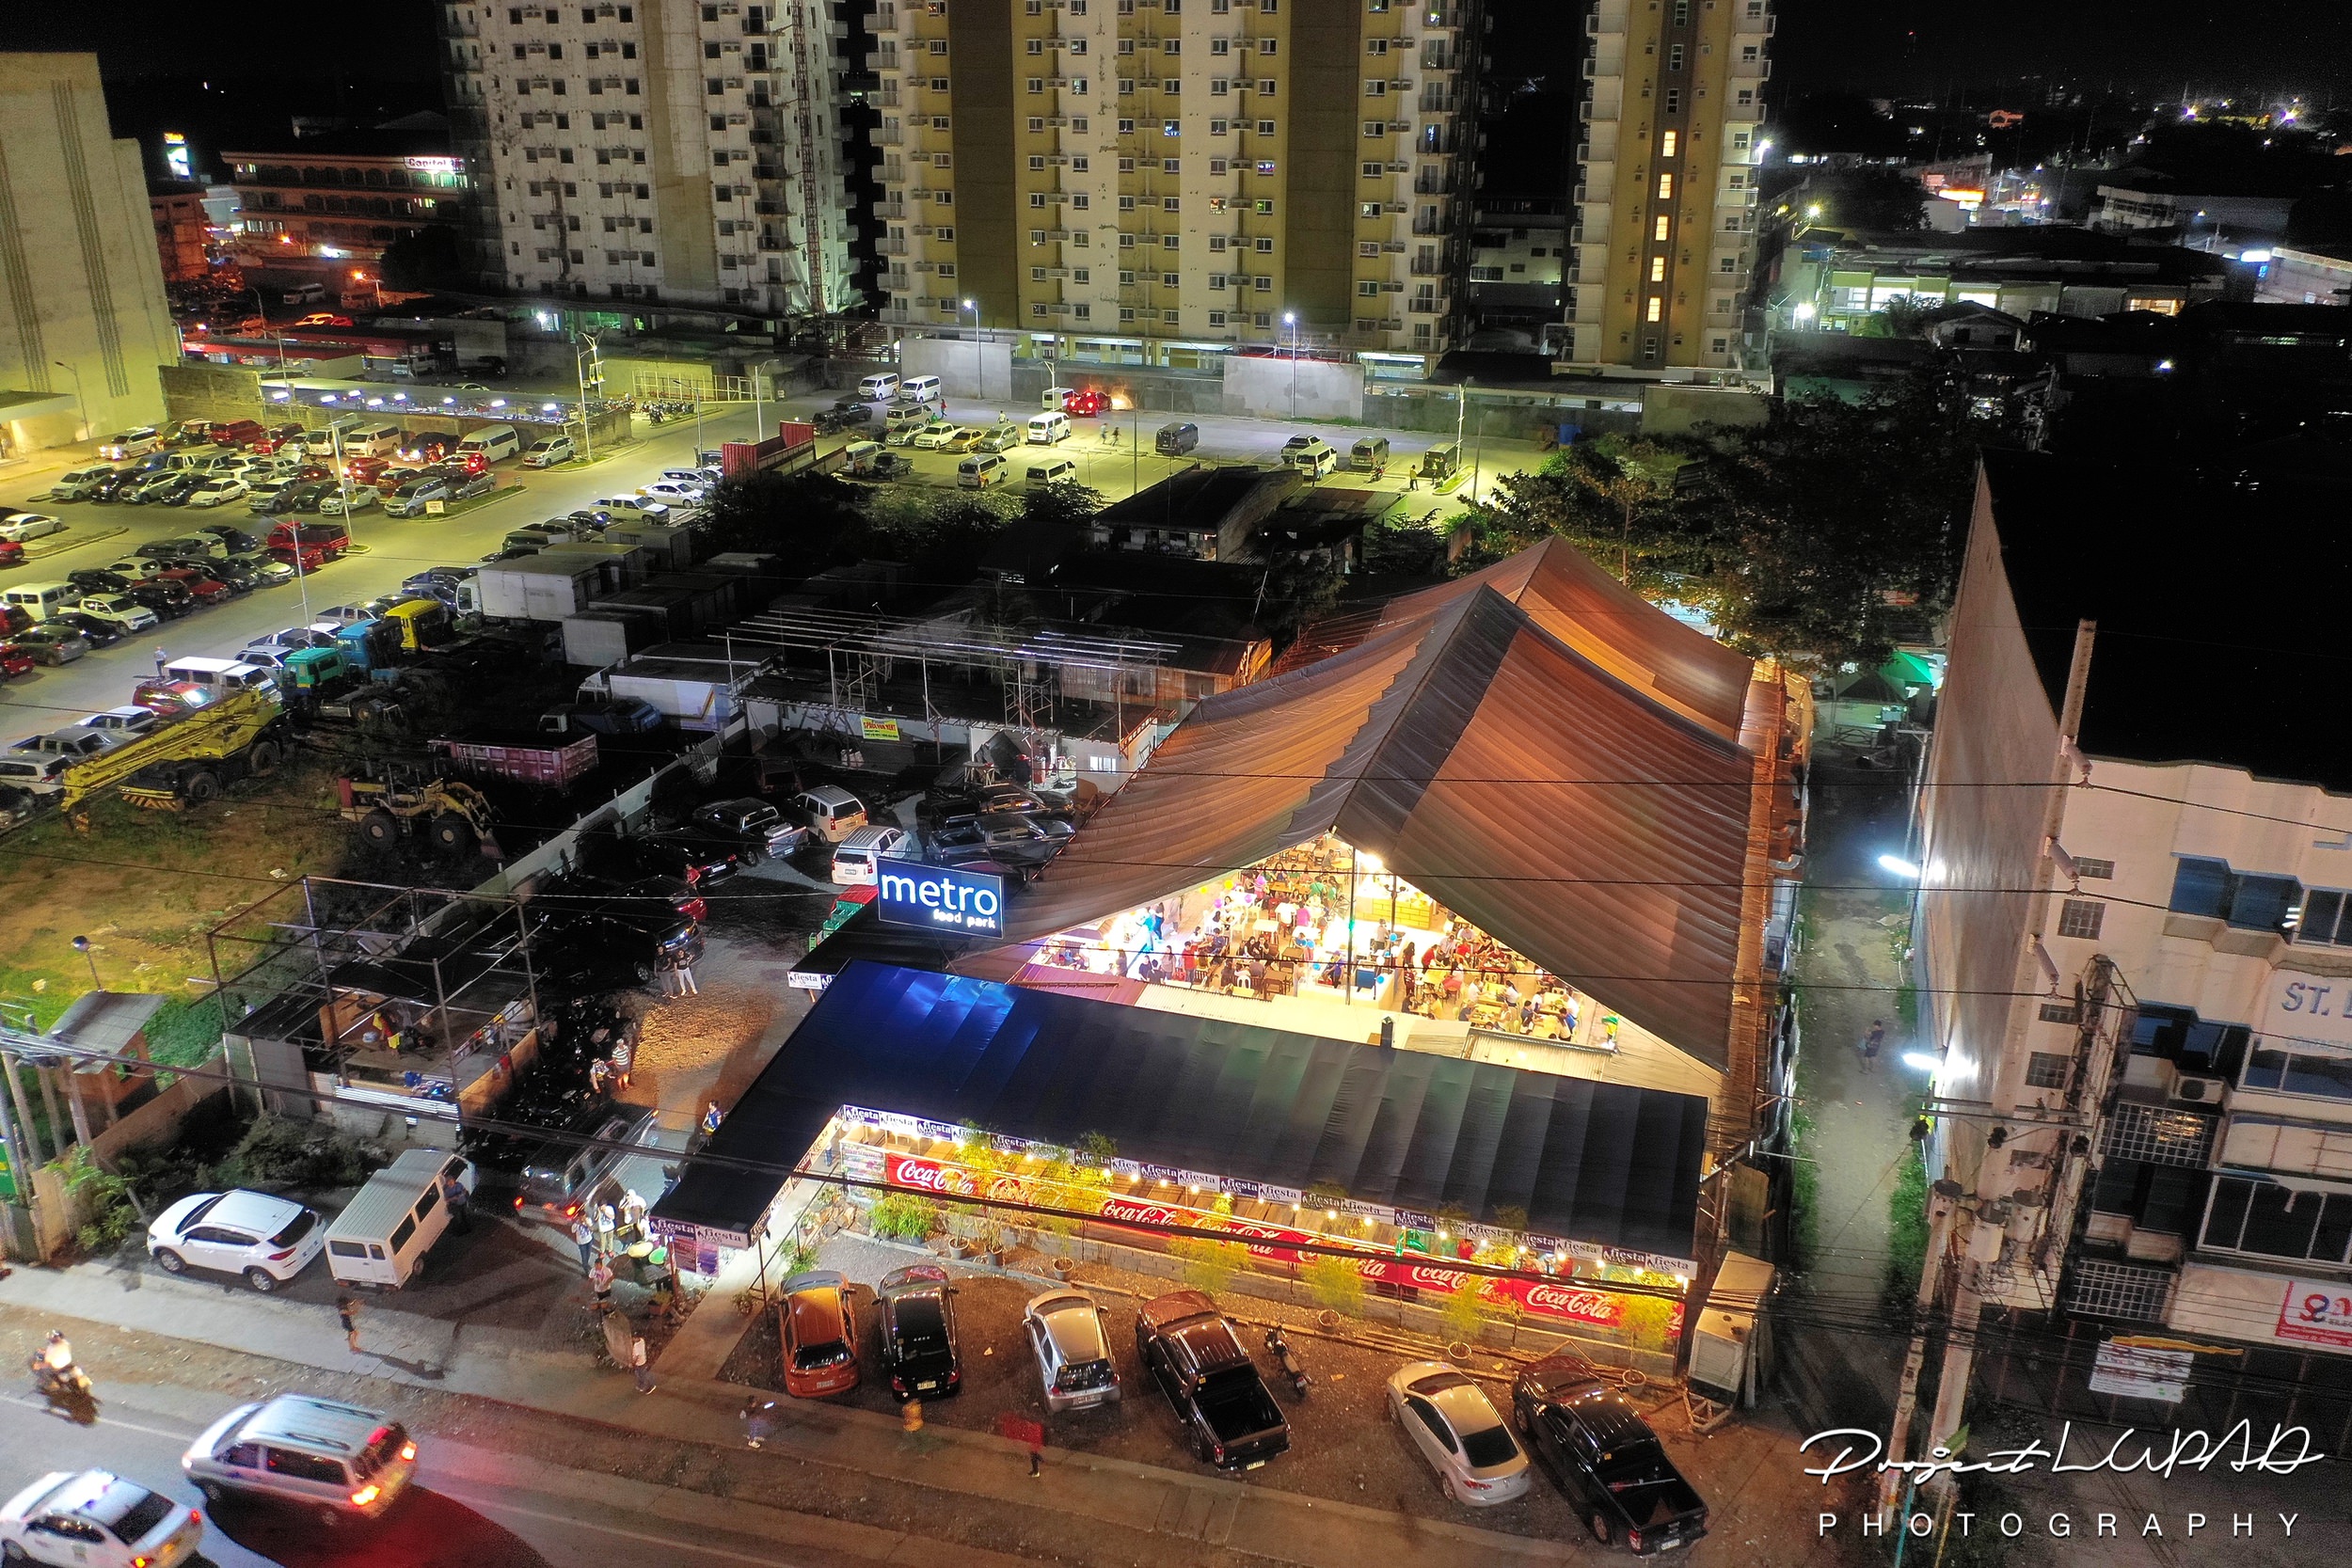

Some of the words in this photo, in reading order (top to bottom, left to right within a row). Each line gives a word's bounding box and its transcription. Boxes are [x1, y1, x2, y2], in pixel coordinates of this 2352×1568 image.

[881, 874, 998, 916] metro
[933, 908, 962, 924] food
[966, 915, 996, 929] park
[2281, 982, 2330, 1016] ST.
[850, 1106, 879, 1120] fiesta
[924, 1121, 951, 1134] fiesta
[997, 1134, 1025, 1148] fiesta
[1147, 1163, 1177, 1178] fiesta
[1185, 1170, 1216, 1184] fiesta
[1227, 1178, 1258, 1192] fiesta
[1265, 1184, 1296, 1199] fiesta
[1309, 1193, 1341, 1208] fiesta
[1348, 1201, 1381, 1215] fiesta
[1403, 1211, 1435, 1225] fiesta
[658, 1219, 694, 1234] fiesta
[705, 1227, 741, 1242] fiesta
[1521, 1232, 1554, 1246] fiesta
[1564, 1240, 1597, 1254] fiesta
[1611, 1248, 1645, 1262] fiesta
[1654, 1256, 1690, 1270] fiesta
[1526, 1284, 1612, 1320] Coca-Cola
